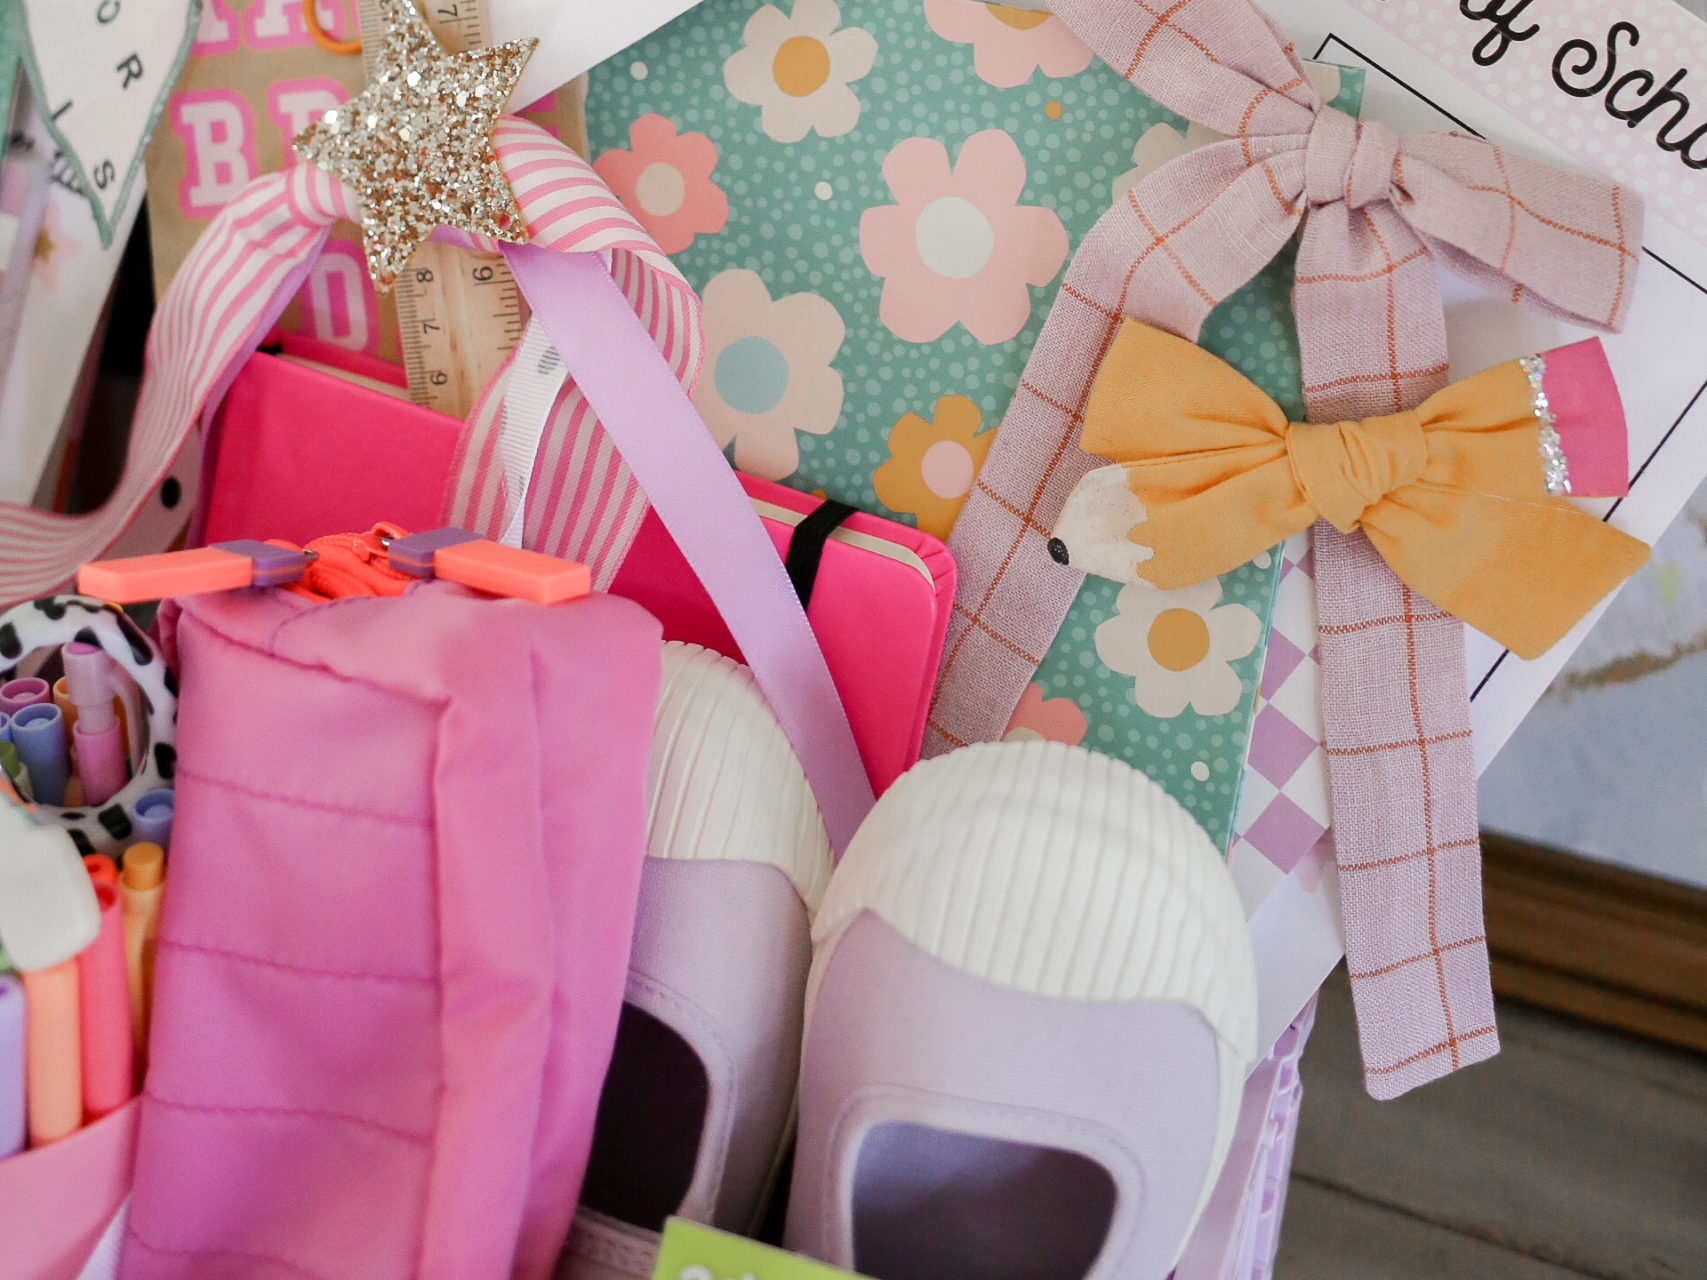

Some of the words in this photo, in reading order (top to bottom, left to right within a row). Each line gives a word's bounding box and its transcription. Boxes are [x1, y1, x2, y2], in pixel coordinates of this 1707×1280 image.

[438, 4, 459, 19] 7
[416, 270, 434, 284] 8
[422, 322, 441, 335] 7
[431, 372, 448, 386] 6
